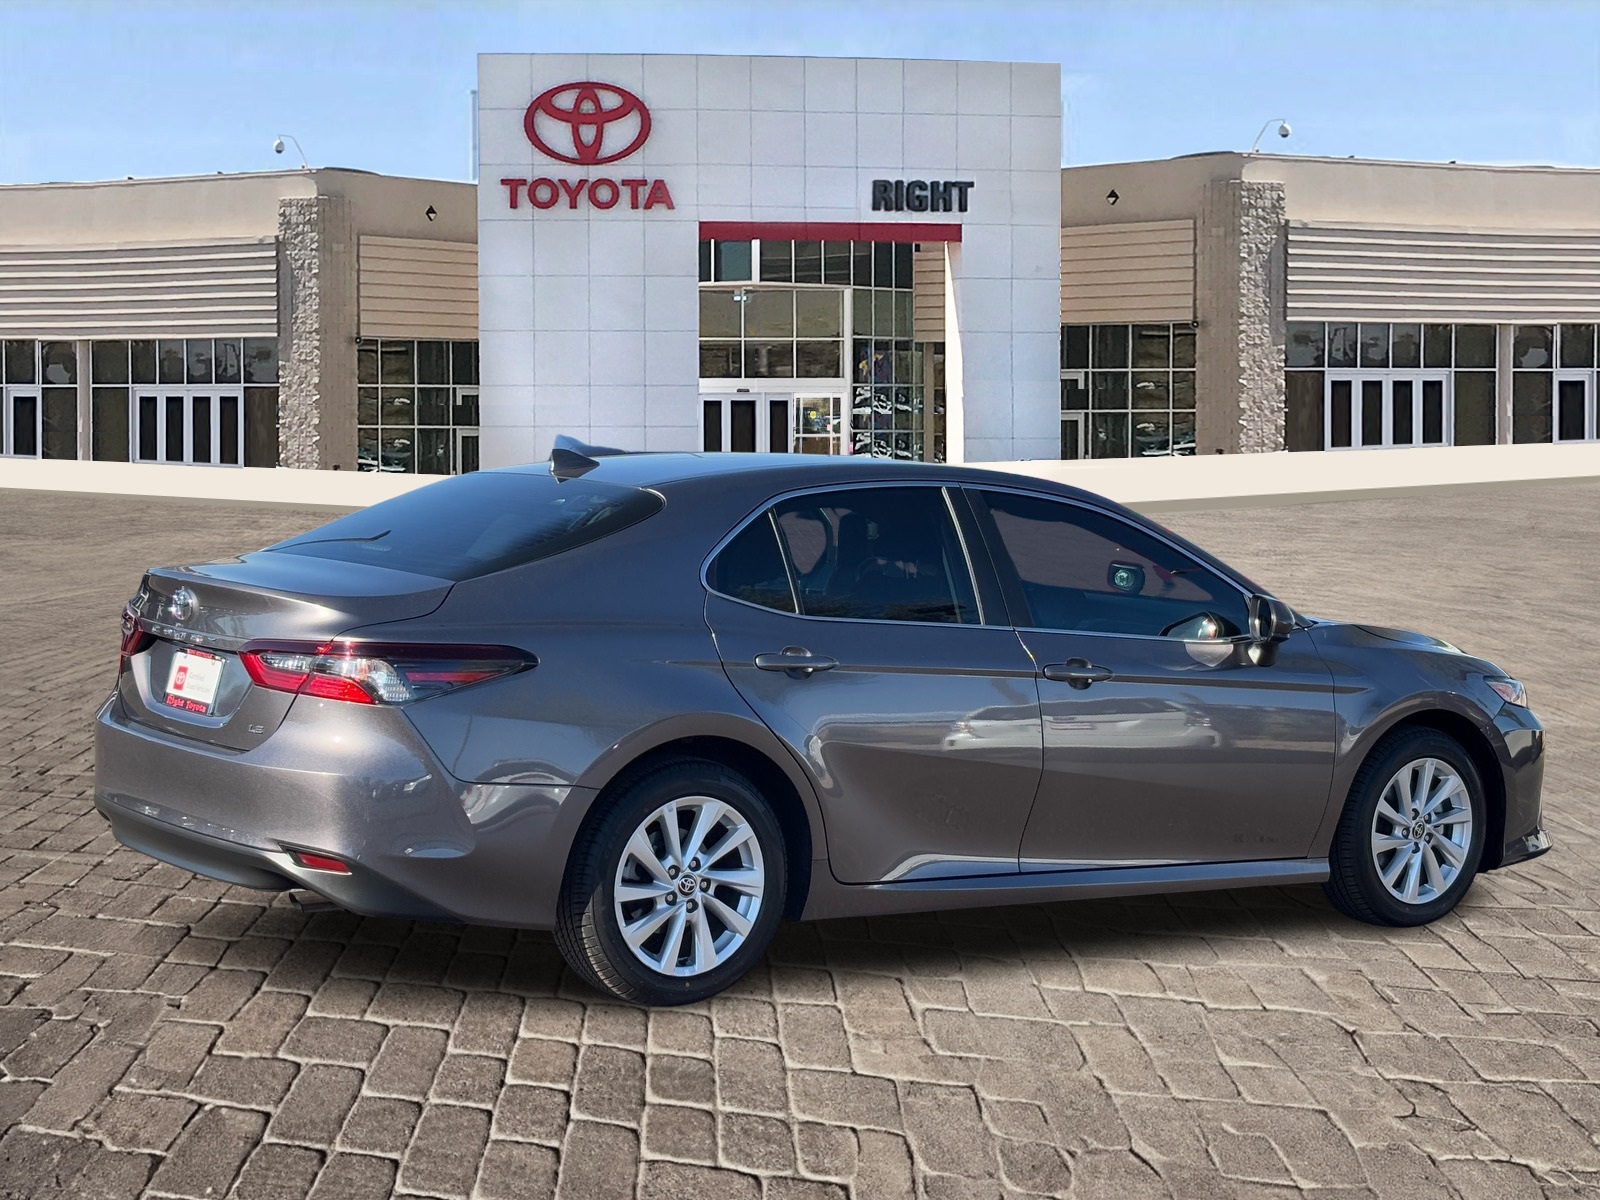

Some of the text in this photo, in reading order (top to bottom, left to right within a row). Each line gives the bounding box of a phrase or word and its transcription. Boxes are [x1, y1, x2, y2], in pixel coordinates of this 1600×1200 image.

[500, 178, 675, 210] TOYOTA
[872, 180, 975, 212] RIGHT
[166, 695, 207, 713] Right Toyota
[248, 724, 265, 735] LE
